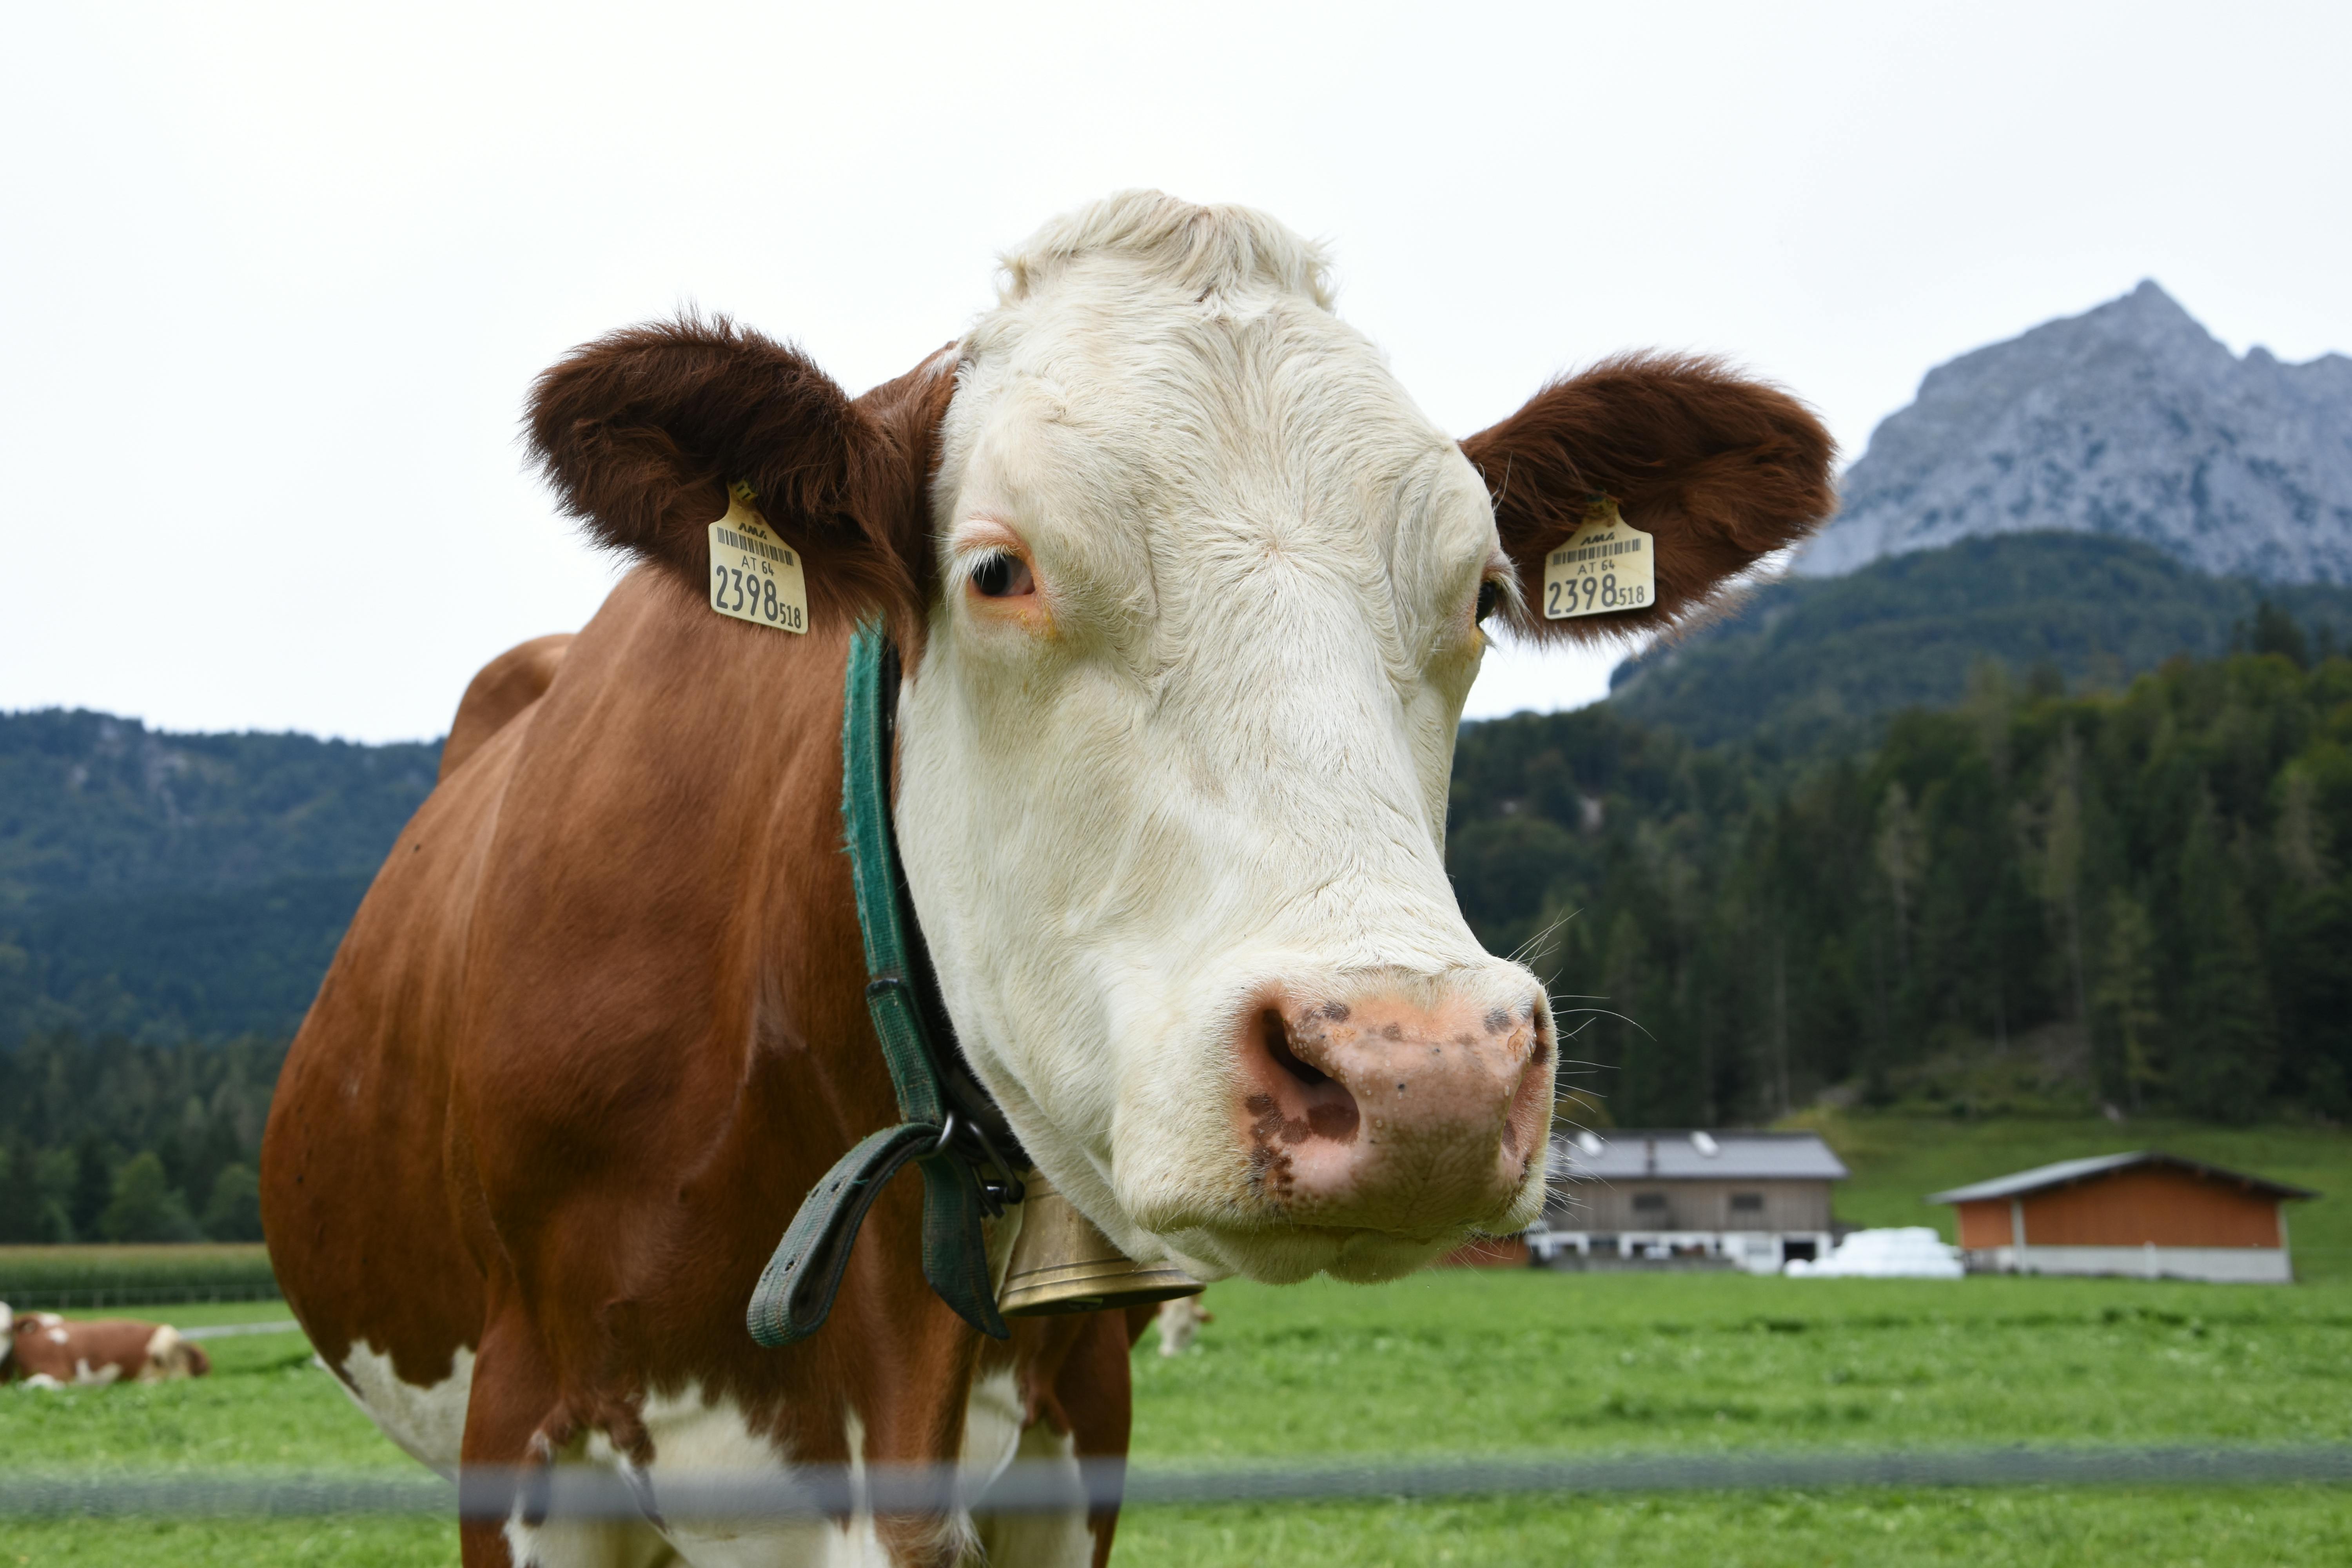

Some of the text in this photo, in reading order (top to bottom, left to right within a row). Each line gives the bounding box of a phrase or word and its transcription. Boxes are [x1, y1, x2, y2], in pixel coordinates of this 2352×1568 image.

[739, 523, 767, 540] AMA
[742, 555, 774, 576] AT 64
[1577, 559, 1615, 575] AT 64
[716, 565, 802, 629] 2398 518
[1549, 573, 1644, 615] 2398 518
